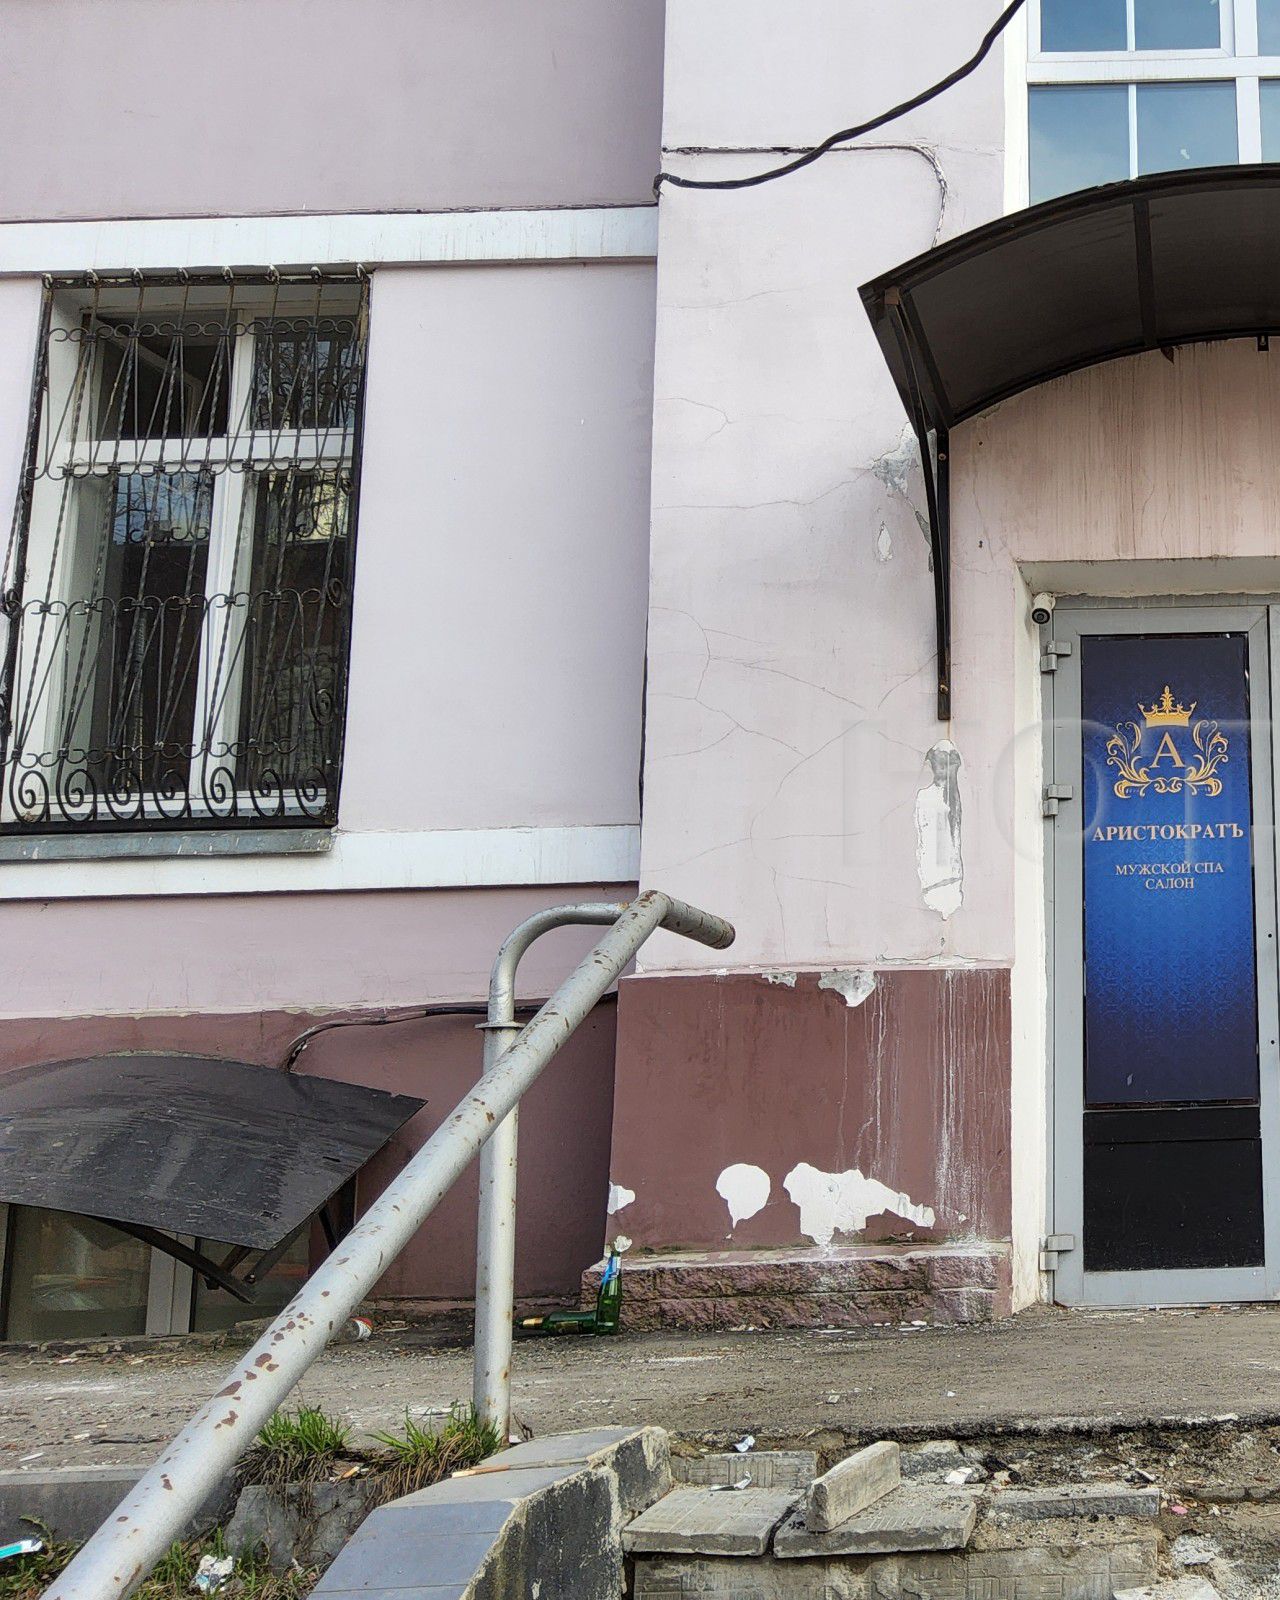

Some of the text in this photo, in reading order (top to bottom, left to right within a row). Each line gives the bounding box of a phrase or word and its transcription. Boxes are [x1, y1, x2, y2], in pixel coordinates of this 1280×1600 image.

[1092, 823, 1245, 842] АРИСТОКРАТЪ
[1115, 861, 1224, 876] МУЖСКОЙ СПА
[1145, 877, 1195, 890] САЛОН
